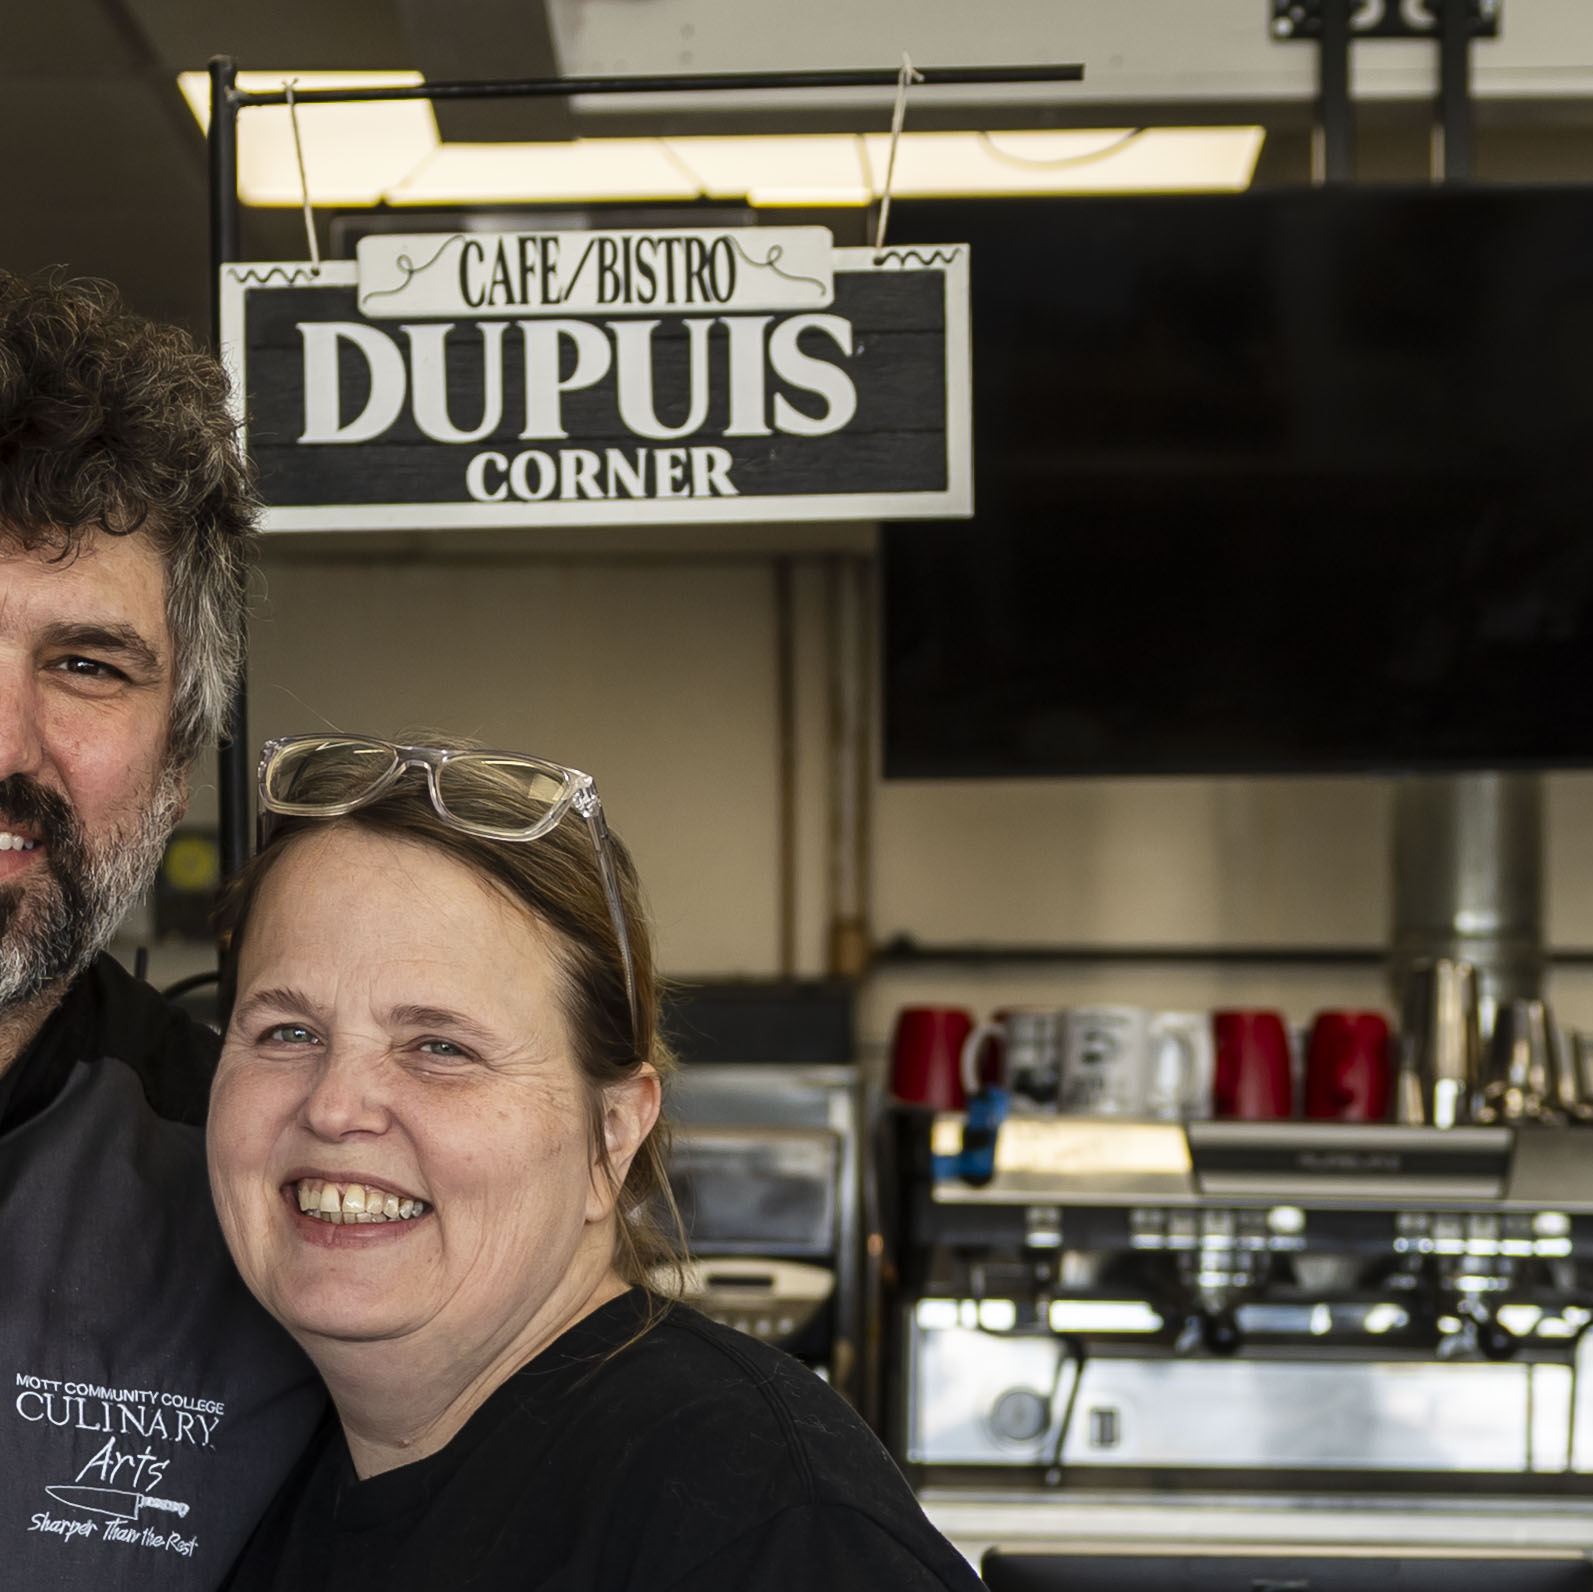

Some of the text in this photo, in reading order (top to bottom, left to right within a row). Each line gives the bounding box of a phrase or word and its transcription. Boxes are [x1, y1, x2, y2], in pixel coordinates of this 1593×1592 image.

[459, 235, 737, 308] CAFE/BISTRO
[296, 313, 858, 443] DUPUIS
[465, 446, 740, 502] CORNER
[16, 1373, 224, 1415] MOTT COMMUNITY COLLEGE
[16, 1391, 220, 1447] CULINARY
[75, 1436, 171, 1493] Arts
[27, 1511, 199, 1557] Sharper Than the Rest
